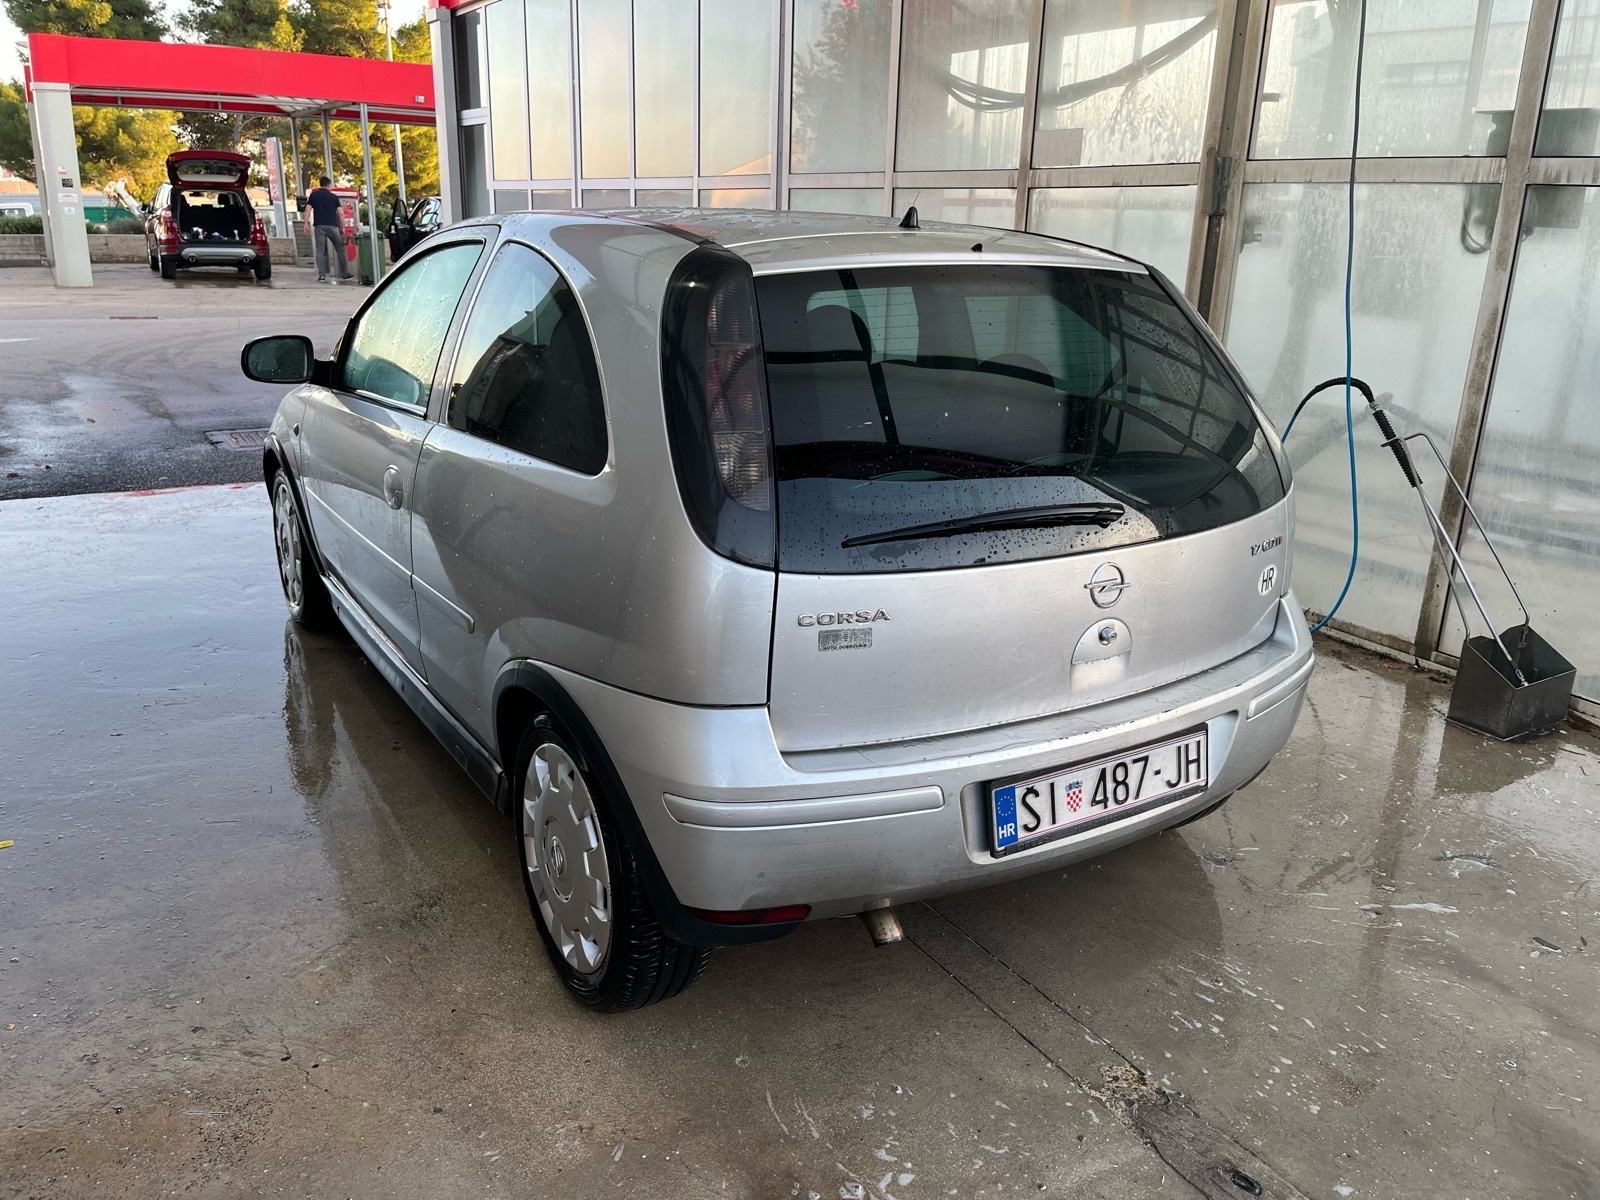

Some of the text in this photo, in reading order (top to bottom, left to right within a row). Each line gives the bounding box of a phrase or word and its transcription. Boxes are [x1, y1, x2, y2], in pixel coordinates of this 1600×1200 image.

[1260, 566, 1275, 593] HR
[797, 608, 891, 627] CORSA
[1020, 781, 1057, 833] ŠI
[1090, 740, 1201, 810] 487-JH
[998, 823, 1016, 838] HR
